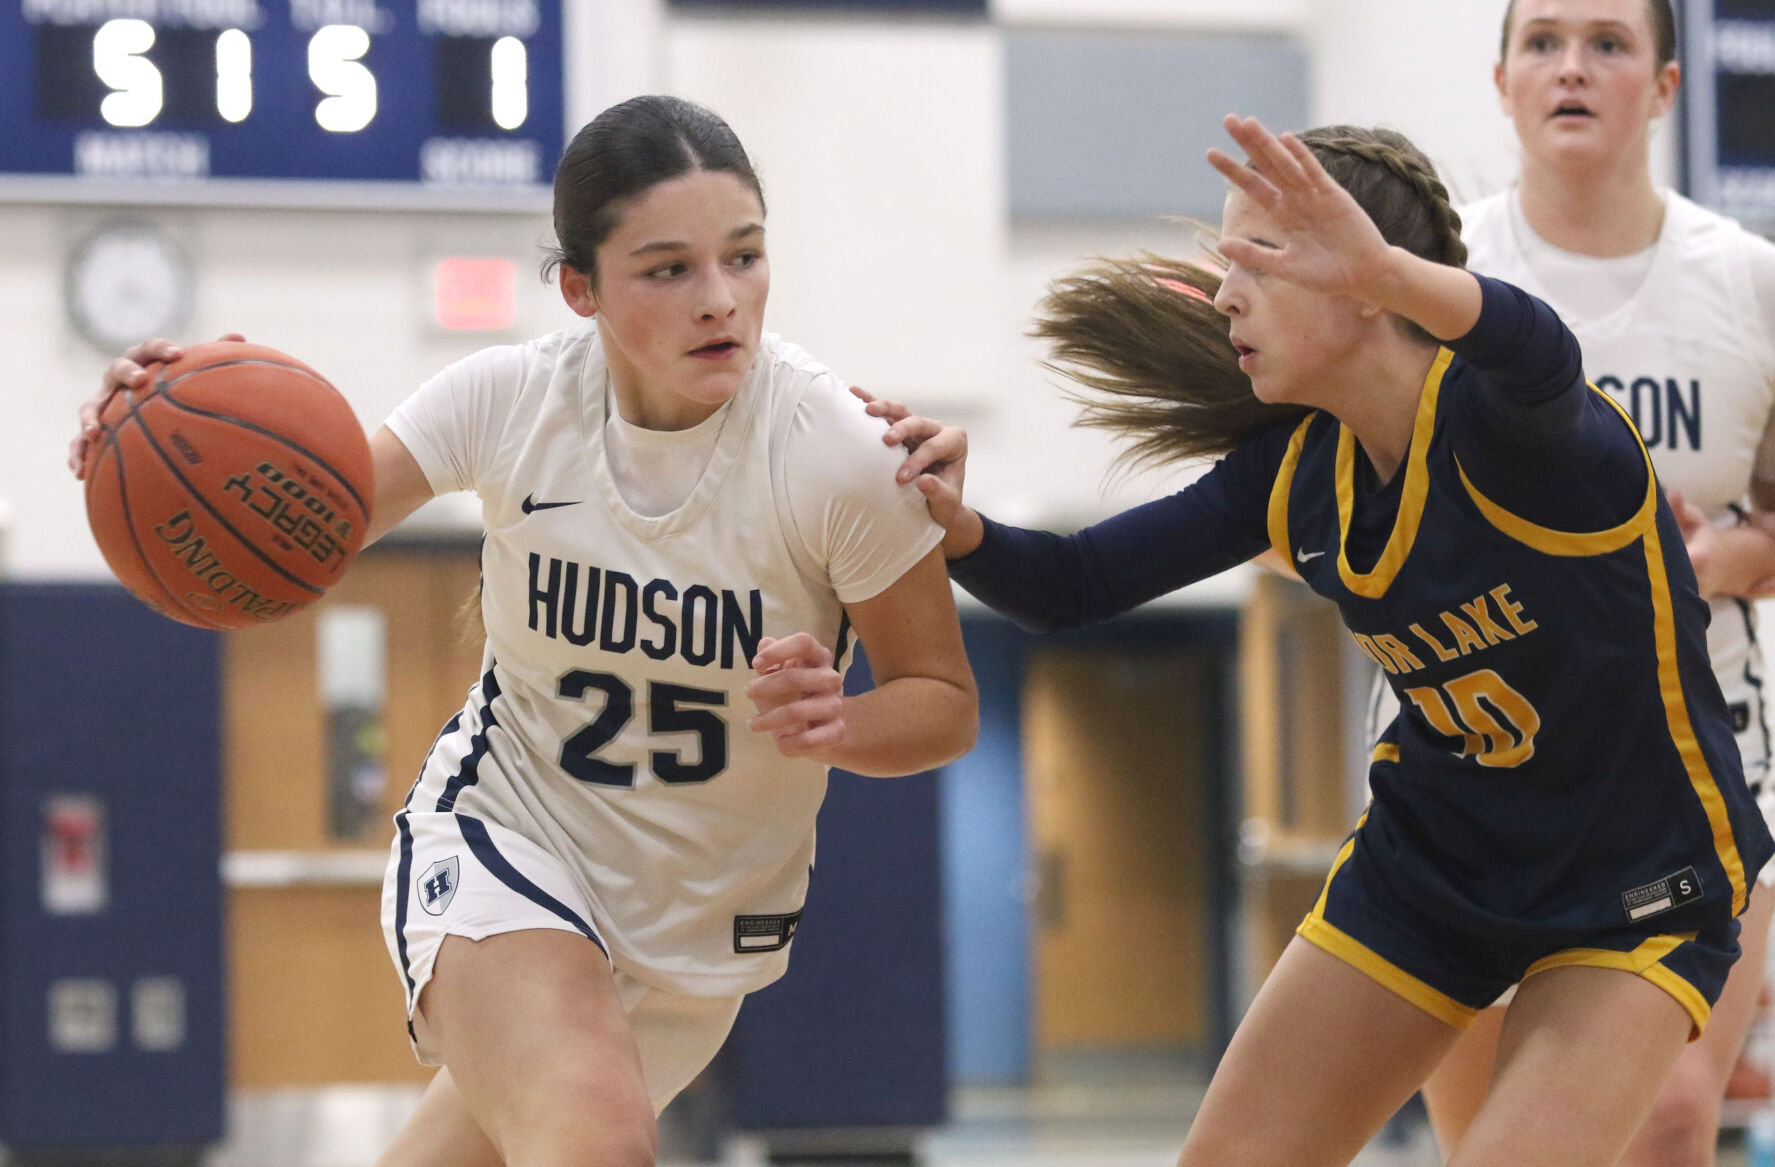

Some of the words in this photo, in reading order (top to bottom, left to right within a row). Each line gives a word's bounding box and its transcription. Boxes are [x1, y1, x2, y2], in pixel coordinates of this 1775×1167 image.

[93, 19, 163, 127] 5
[308, 24, 377, 132] 5
[491, 36, 528, 130] 1
[1596, 375, 1702, 452] ON
[223, 473, 347, 574] LEGACY
[255, 462, 336, 524] 1000
[528, 552, 763, 670] HUDSON
[1408, 583, 1539, 662] LAKE
[555, 666, 730, 792] 25
[1403, 668, 1541, 769] 10
[424, 868, 453, 908] H
[1624, 882, 1667, 900] ENGINEERED
[1679, 880, 1692, 895] S
